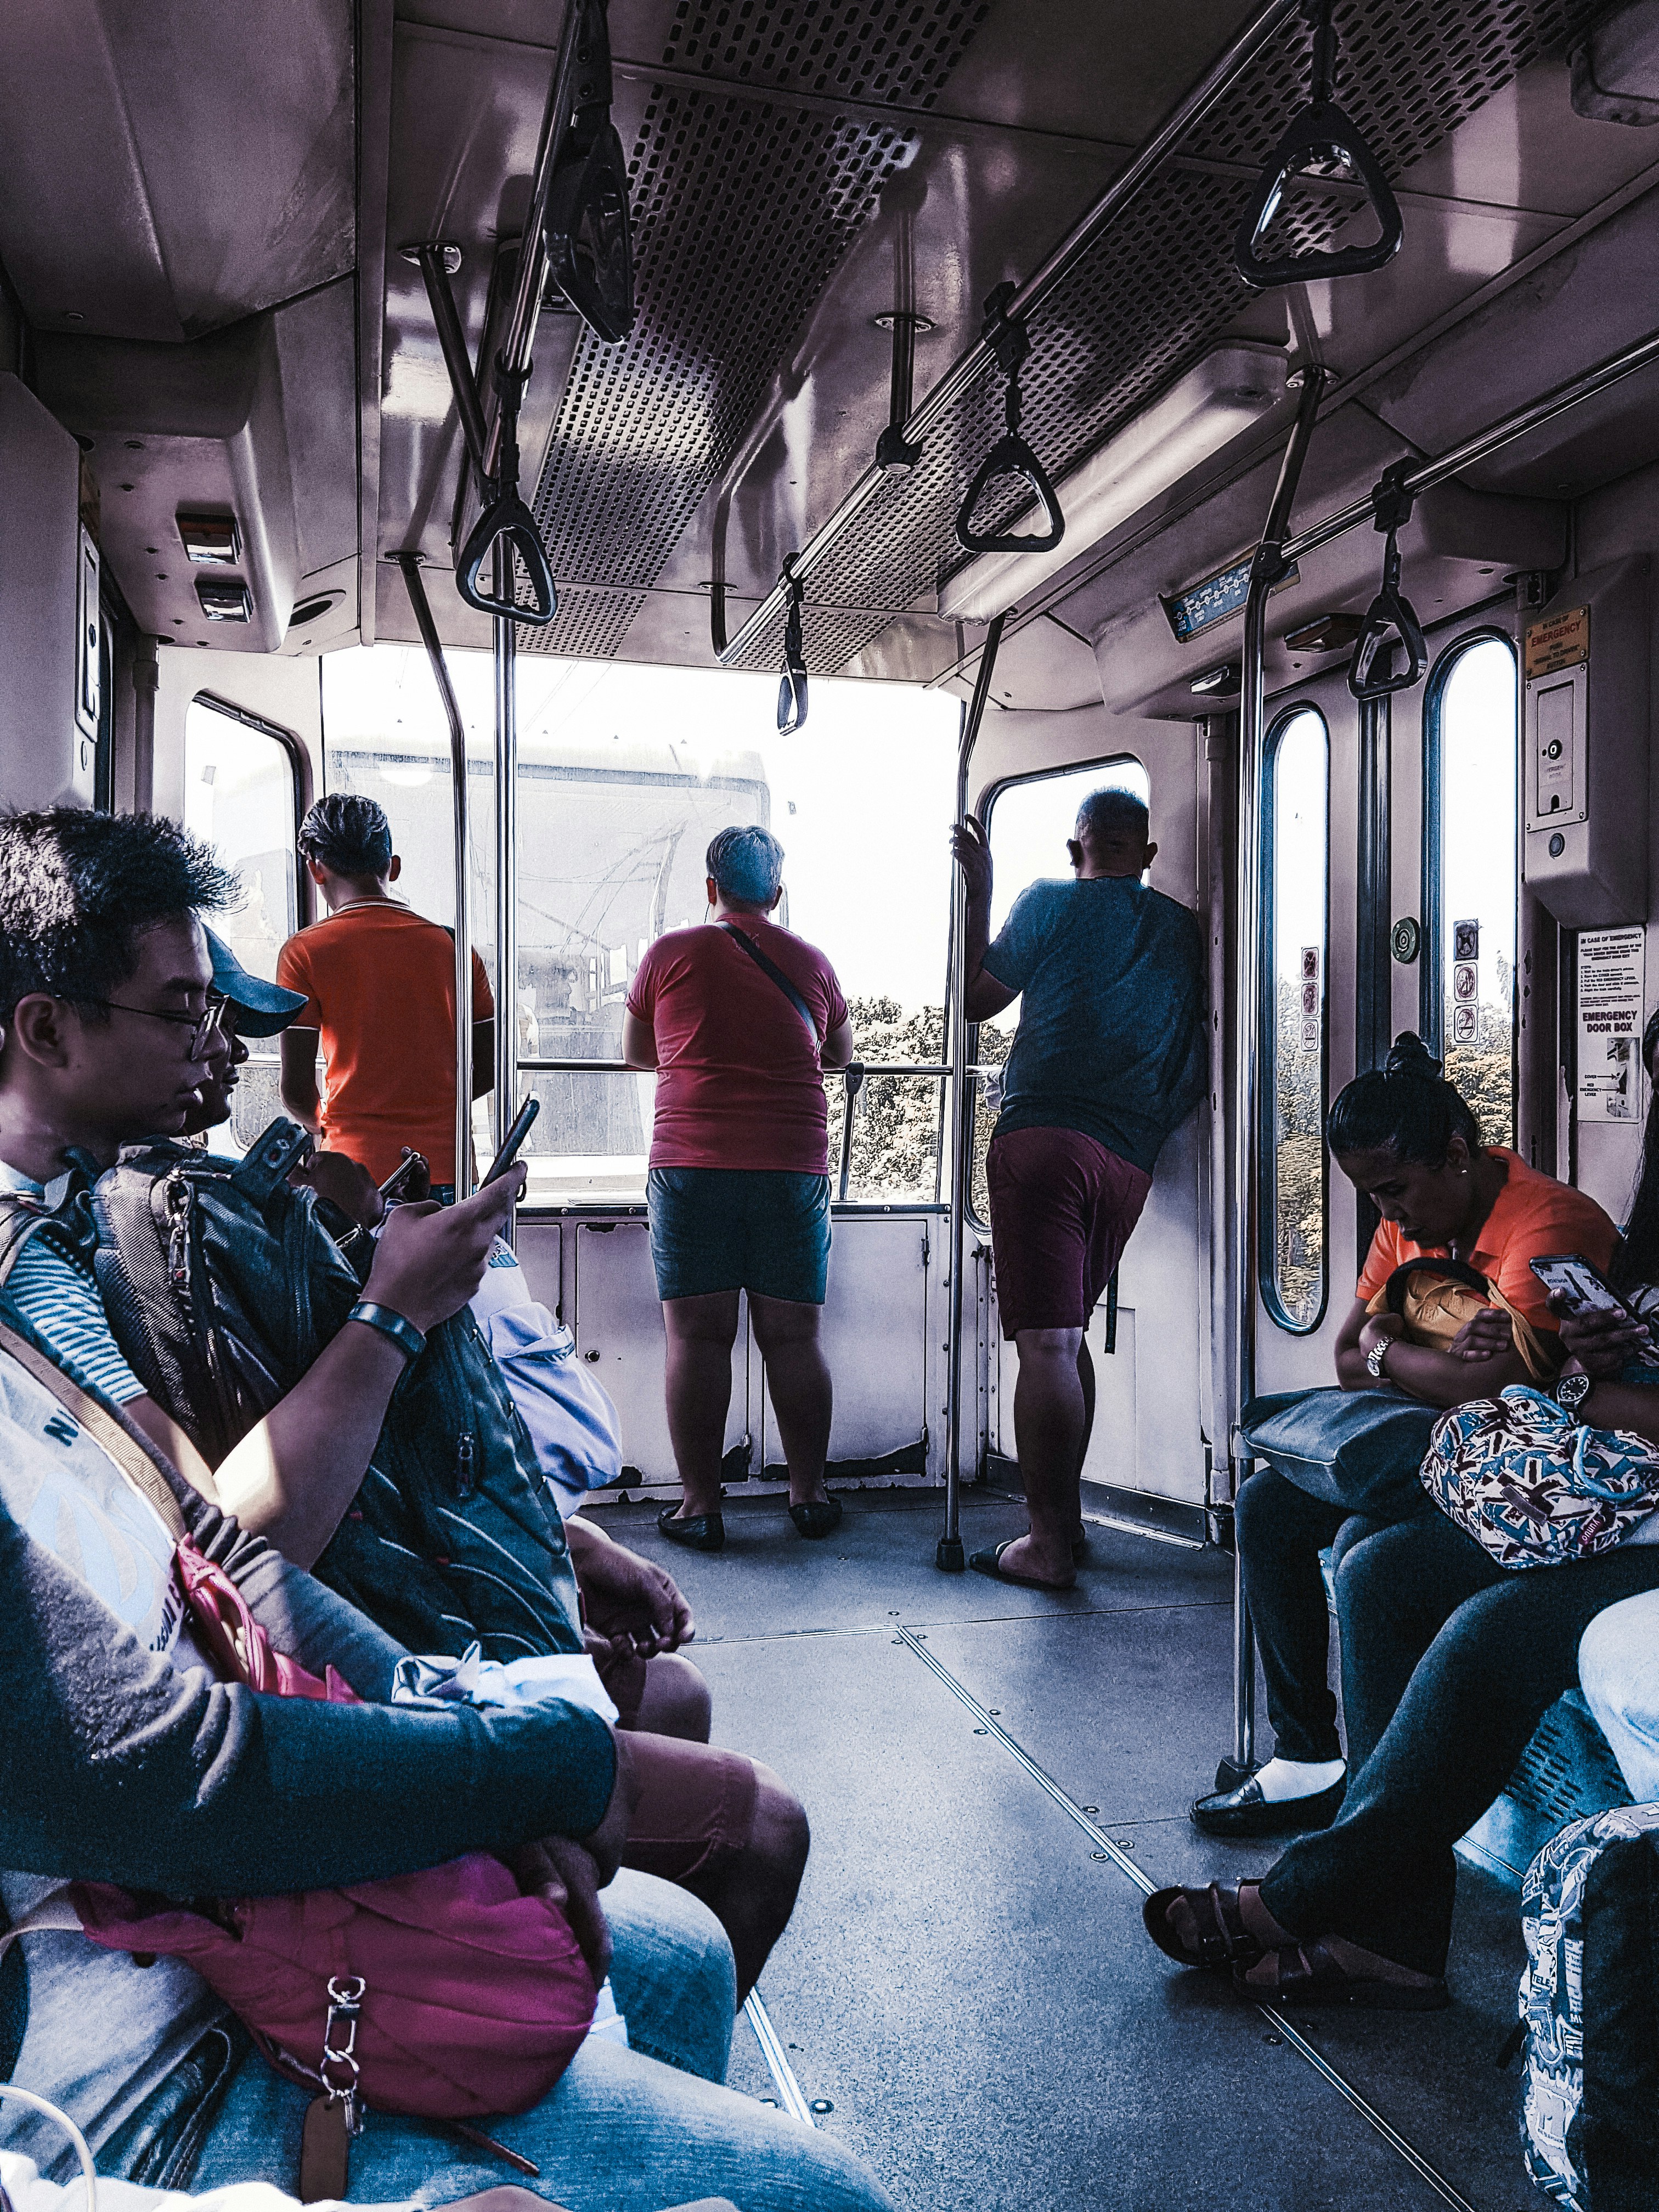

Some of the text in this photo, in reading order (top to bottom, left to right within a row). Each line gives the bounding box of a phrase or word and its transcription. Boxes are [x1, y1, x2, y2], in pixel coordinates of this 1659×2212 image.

[1531, 620, 1581, 648] EMERGENCY
[1609, 933, 1642, 941] EMERGENCY
[1583, 1010, 1638, 1022] EMERGENCY
[1587, 1022, 1633, 1032] DOOR BOX
